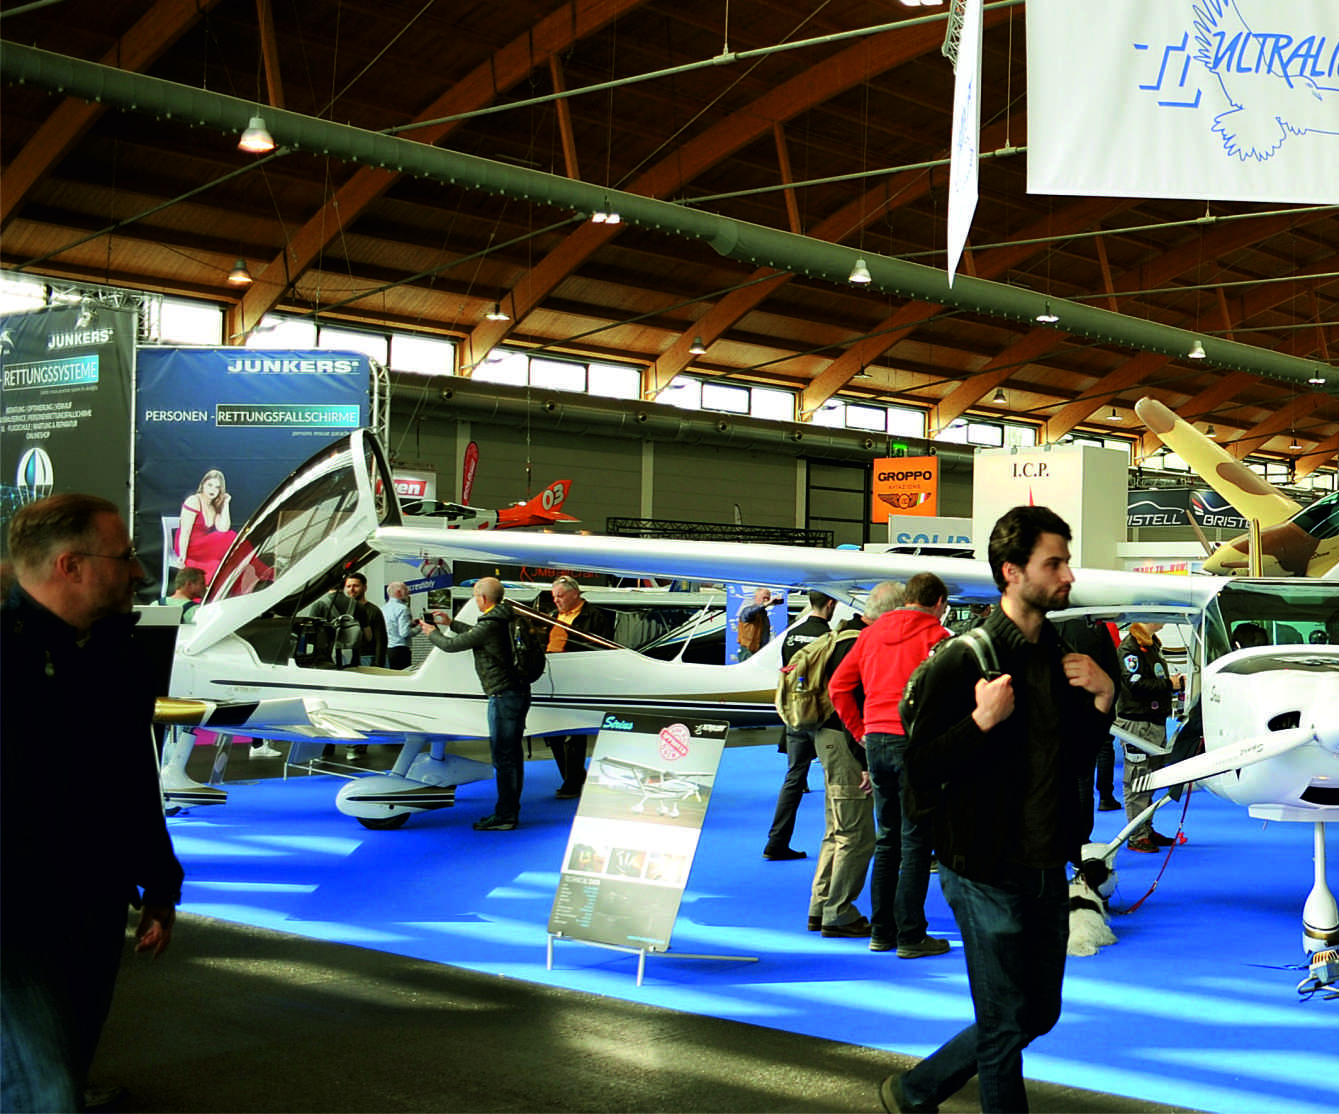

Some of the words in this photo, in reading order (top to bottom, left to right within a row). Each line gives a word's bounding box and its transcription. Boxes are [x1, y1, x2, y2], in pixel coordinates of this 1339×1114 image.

[48, 329, 111, 348] JUNKERS
[4, 361, 97, 387] RETTUNGSSYSTEME
[227, 360, 353, 374] JUNKERS
[145, 410, 208, 422] PERSONEN
[218, 411, 357, 423] RETTUNGSFALLSCHIRME
[878, 470, 932, 482] GROPPO
[1013, 462, 1050, 478] I.C.P.
[542, 483, 565, 511] 03
[1127, 514, 1181, 526] ISTELL
